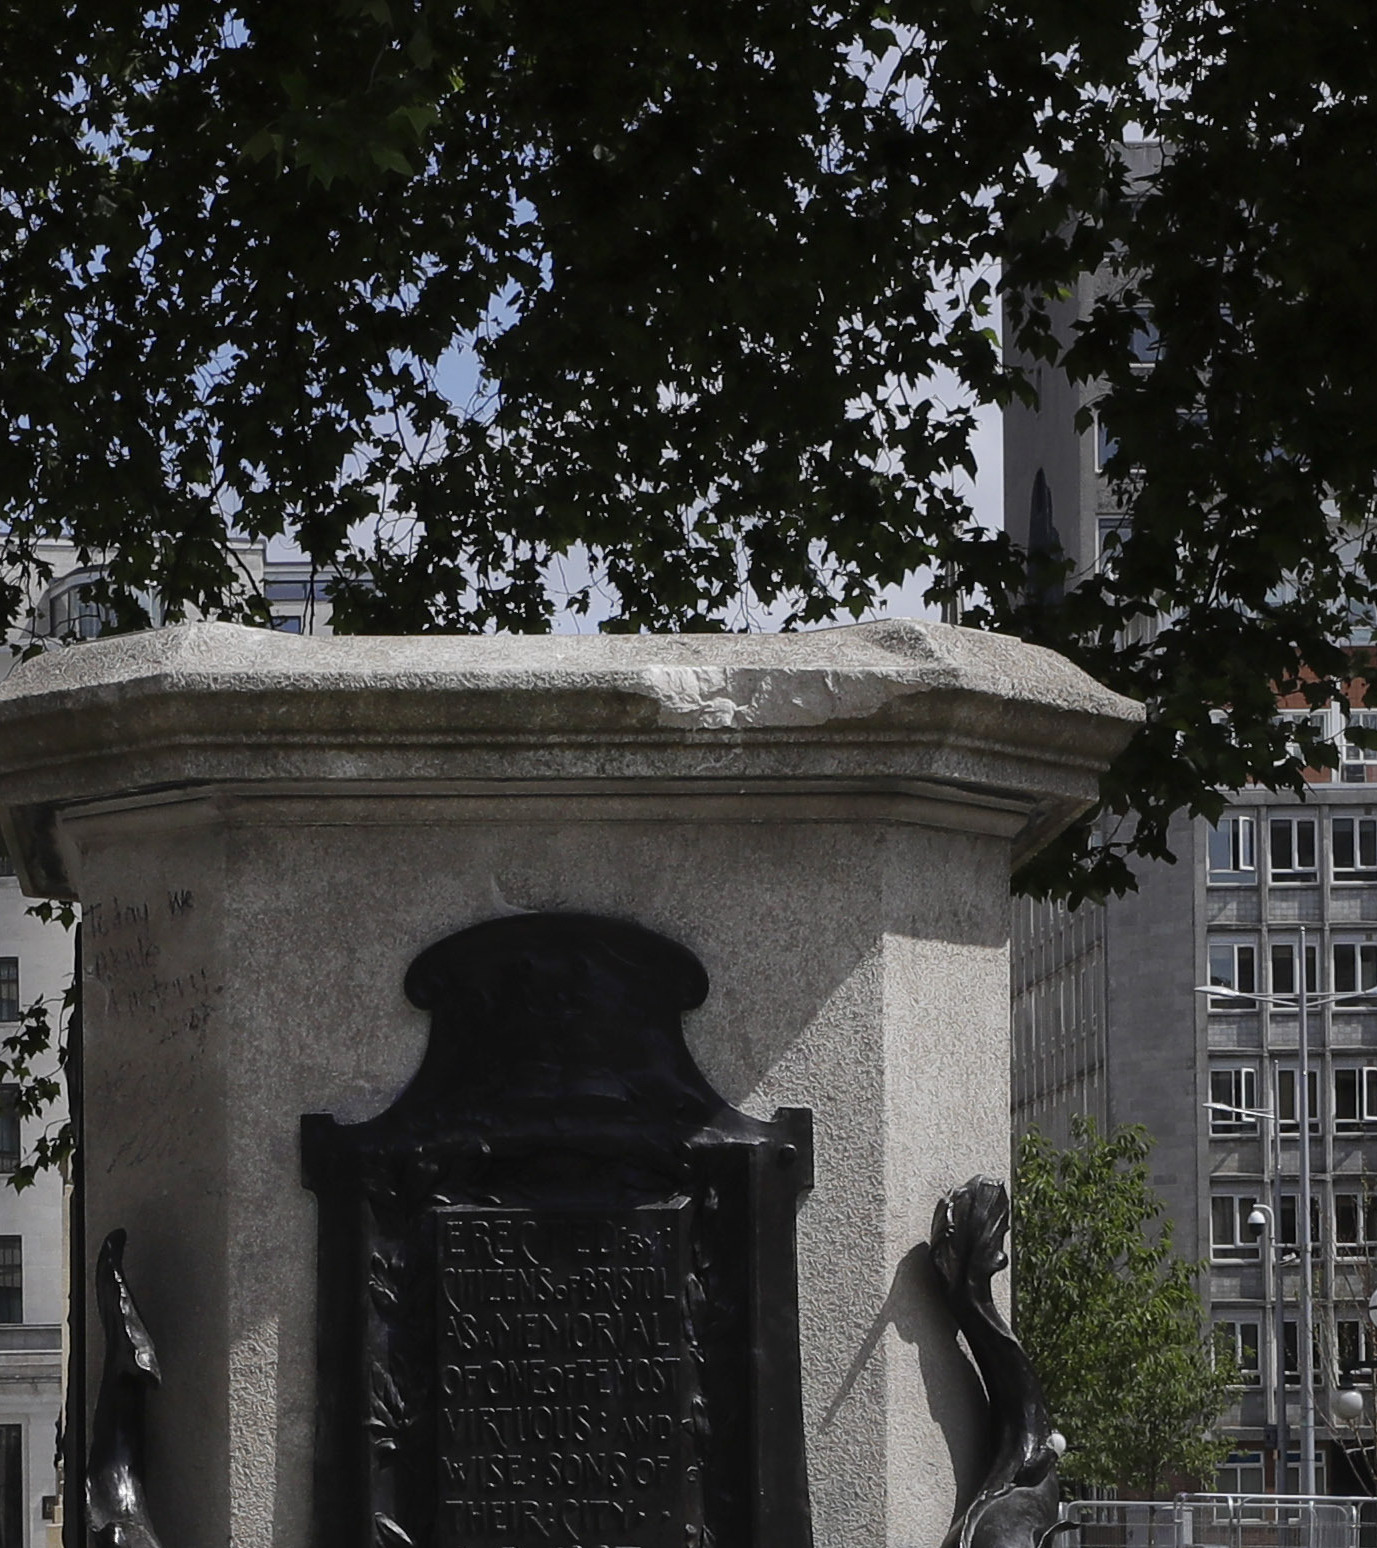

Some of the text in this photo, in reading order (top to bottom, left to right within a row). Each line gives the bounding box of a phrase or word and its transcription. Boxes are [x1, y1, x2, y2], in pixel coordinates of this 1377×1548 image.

[442, 1266, 553, 1312] CITIZENS
[581, 1265, 676, 1311] BRISTOL
[446, 1314, 479, 1349] AS
[495, 1312, 670, 1349] MEMORIAL
[442, 1363, 482, 1396] OF
[484, 1359, 547, 1396] ONE
[612, 1354, 681, 1395] MOST
[621, 1413, 674, 1443] AND
[545, 1451, 627, 1488] SONS
[635, 1453, 671, 1486] OF
